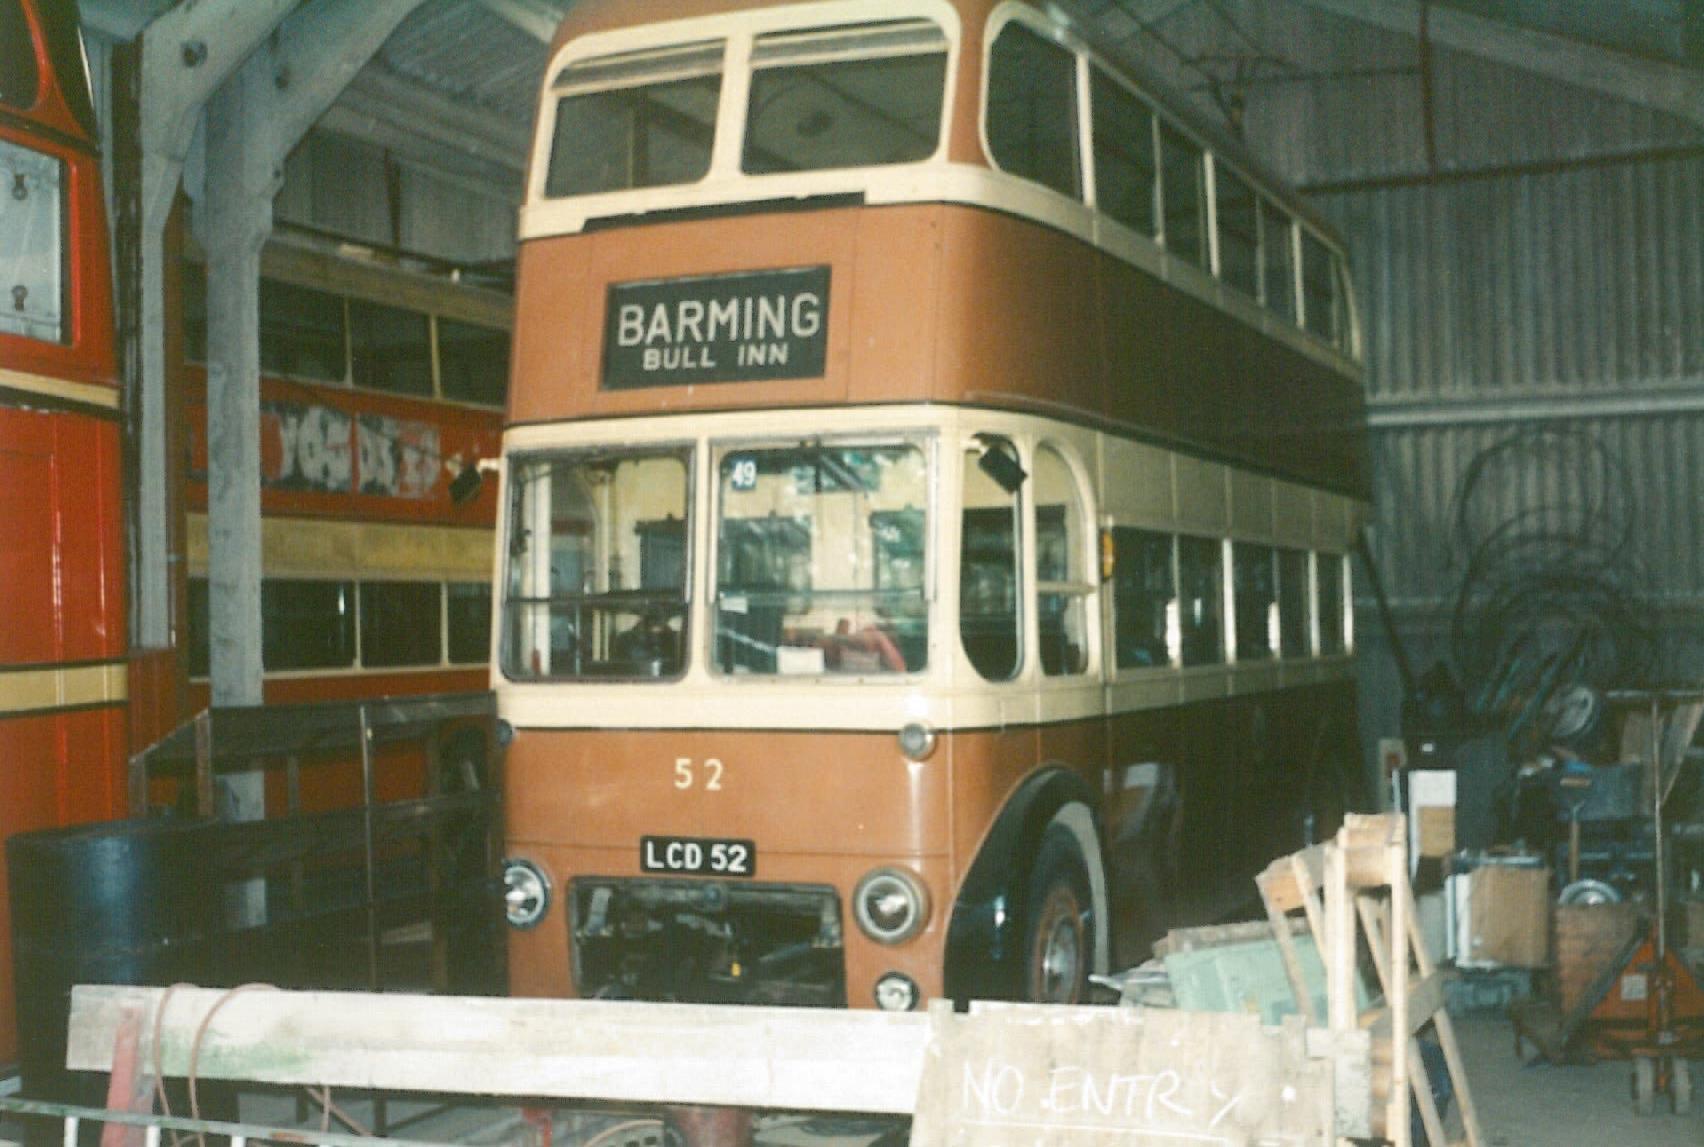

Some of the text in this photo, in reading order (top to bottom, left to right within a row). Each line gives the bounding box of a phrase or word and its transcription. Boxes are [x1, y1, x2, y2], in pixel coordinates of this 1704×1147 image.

[617, 292, 821, 347] BARMING
[642, 343, 788, 371] BULL INN
[646, 840, 748, 873] LCD 52
[962, 1057, 1242, 1129] NO ENTRY
